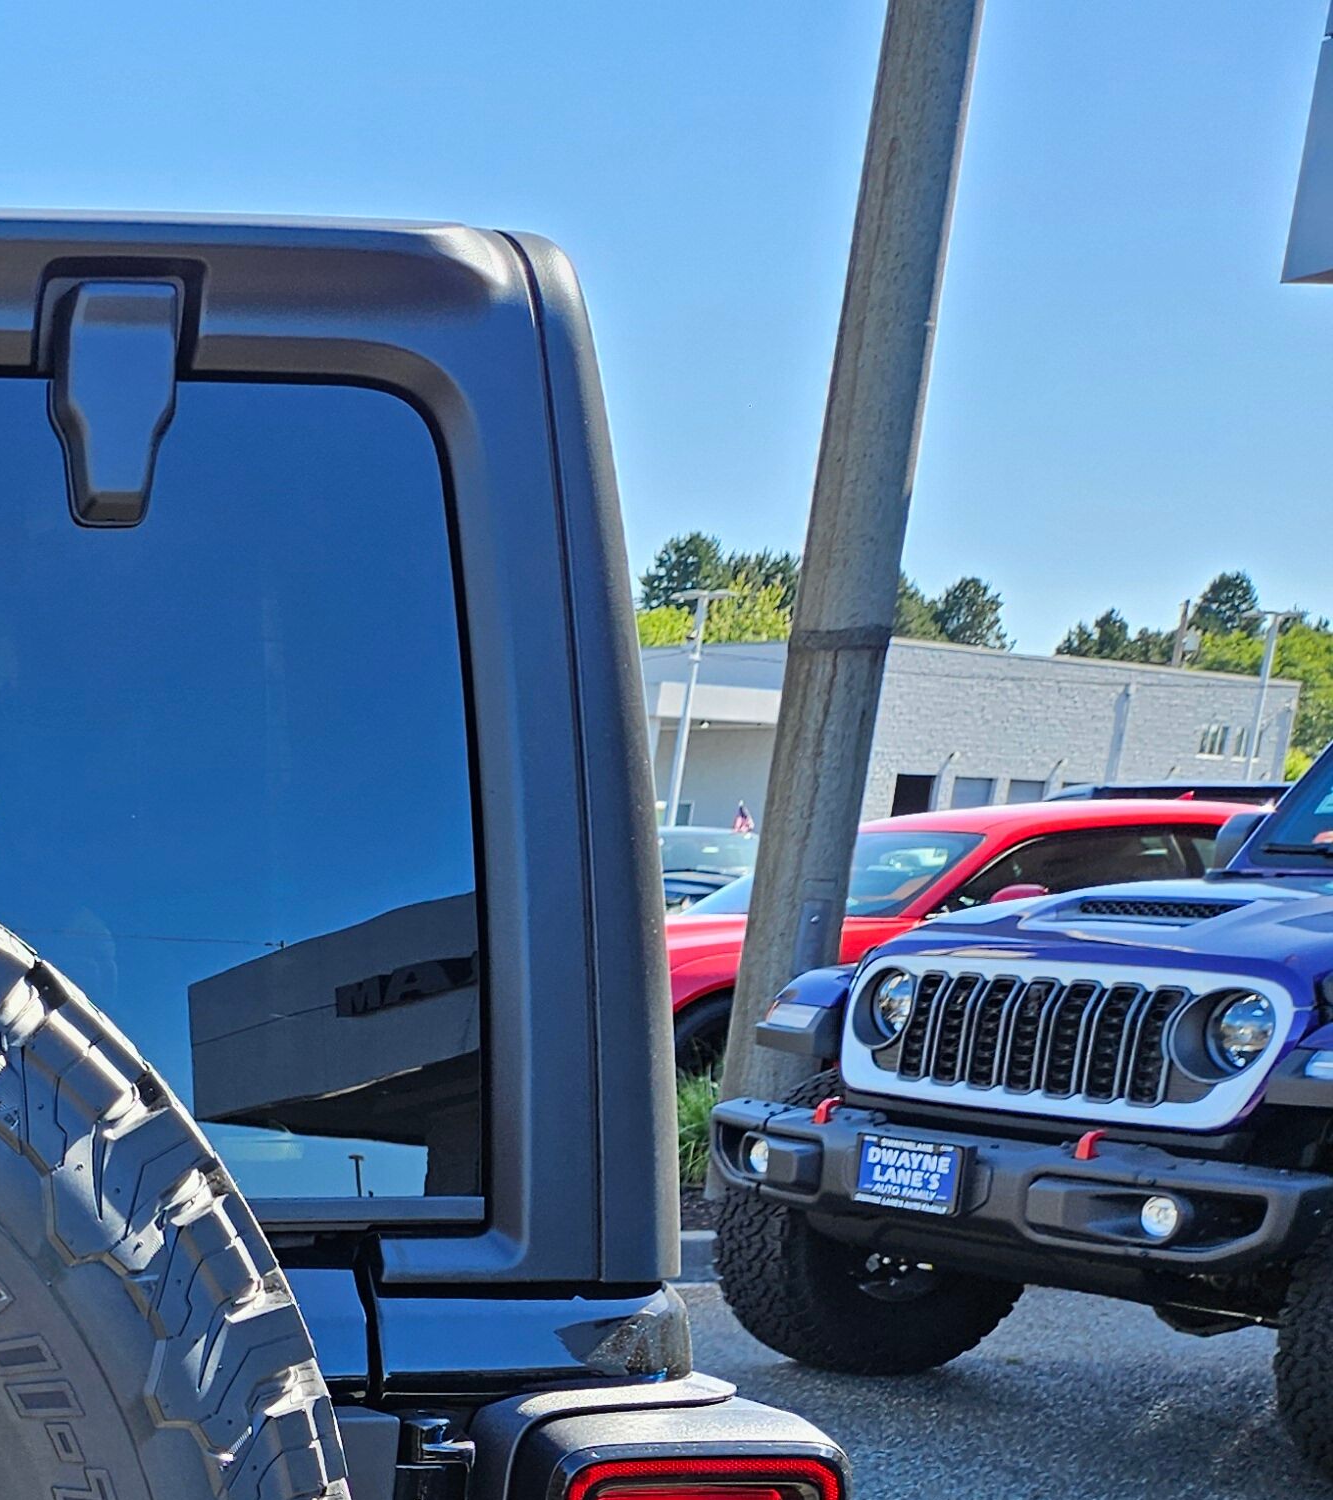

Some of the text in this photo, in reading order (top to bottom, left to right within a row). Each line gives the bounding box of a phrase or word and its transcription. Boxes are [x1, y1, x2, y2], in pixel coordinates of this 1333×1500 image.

[866, 1145, 952, 1175] DWAYNE
[872, 1164, 941, 1191] LANE'S
[871, 1182, 937, 1202] AUTO FAMILY
